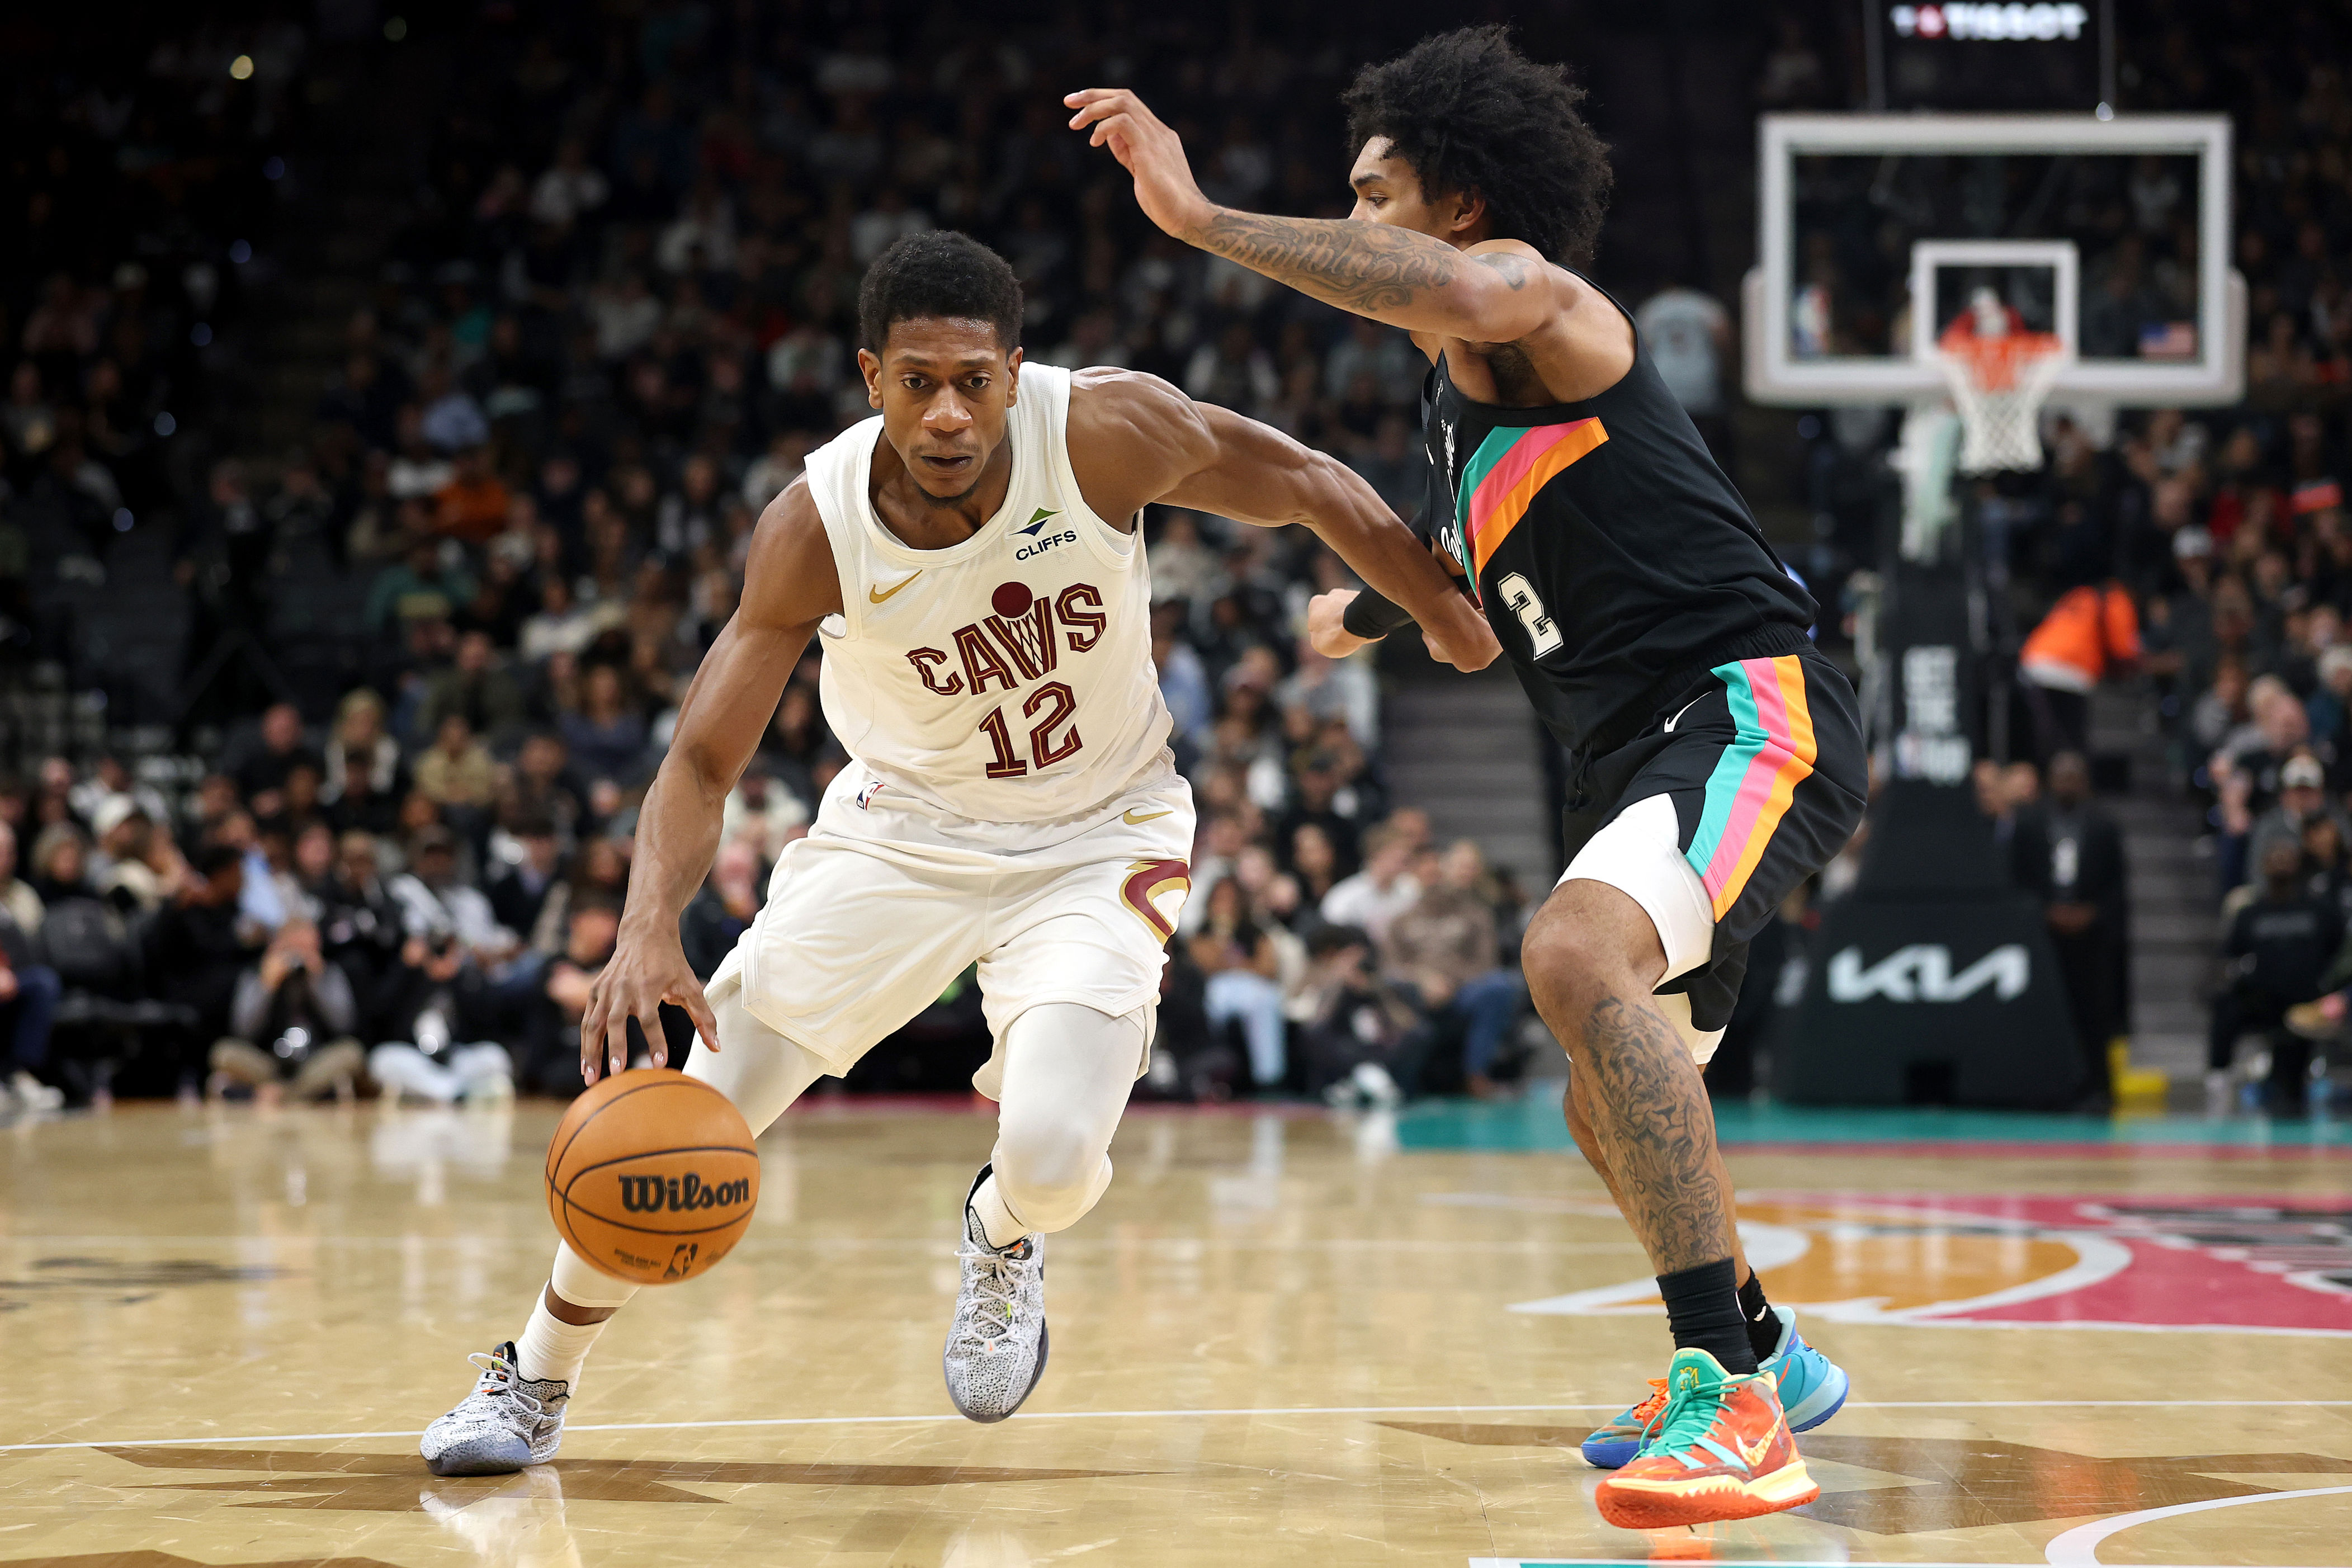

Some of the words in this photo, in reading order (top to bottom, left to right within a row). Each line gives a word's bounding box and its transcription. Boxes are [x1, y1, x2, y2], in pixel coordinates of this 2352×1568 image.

[1943, 2, 2088, 41] TISSOT
[1016, 530, 1077, 560] CLIFFS
[904, 583, 1107, 696] CAVS
[1497, 571, 1564, 661] 2
[978, 681, 1083, 779] 12
[1827, 943, 2029, 1003] KIA
[618, 1171, 750, 1213] Wilson
